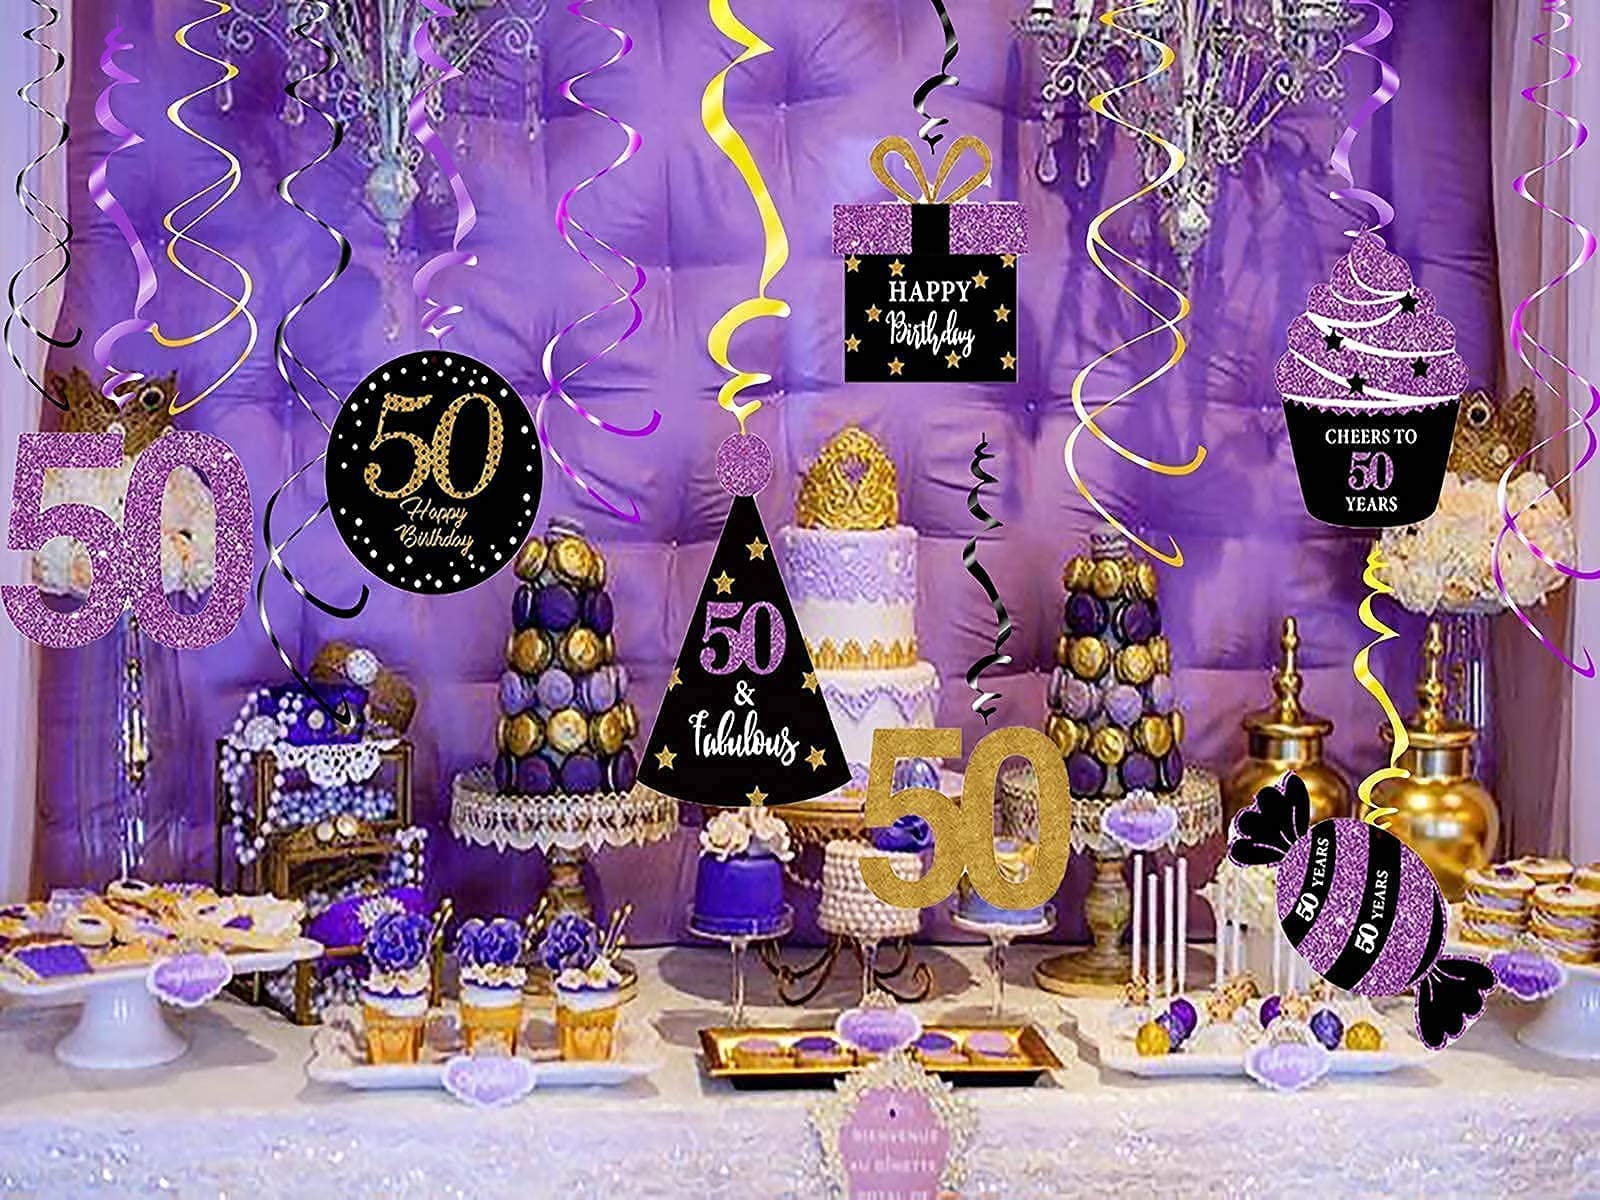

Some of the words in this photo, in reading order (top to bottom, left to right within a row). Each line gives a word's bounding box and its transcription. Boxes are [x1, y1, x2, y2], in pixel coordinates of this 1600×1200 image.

[888, 280, 972, 303] HAPPY
[885, 308, 976, 358] Birthday
[363, 392, 504, 499] 50
[1325, 428, 1391, 445] CHEERS
[1393, 428, 1418, 445] TO
[1348, 451, 1394, 491] 50
[400, 496, 469, 528] Happy
[1345, 496, 1398, 512] YEARS
[0, 430, 254, 649] 50
[394, 523, 474, 557] Birthday
[700, 601, 787, 675] 50
[734, 680, 756, 706] &
[688, 709, 800, 766] Fabulous
[858, 726, 1071, 911] 50
[1295, 892, 1319, 922] 50
[1311, 837, 1330, 887] YEARS
[1354, 922, 1379, 954] 50
[1371, 869, 1388, 920] YEARS
